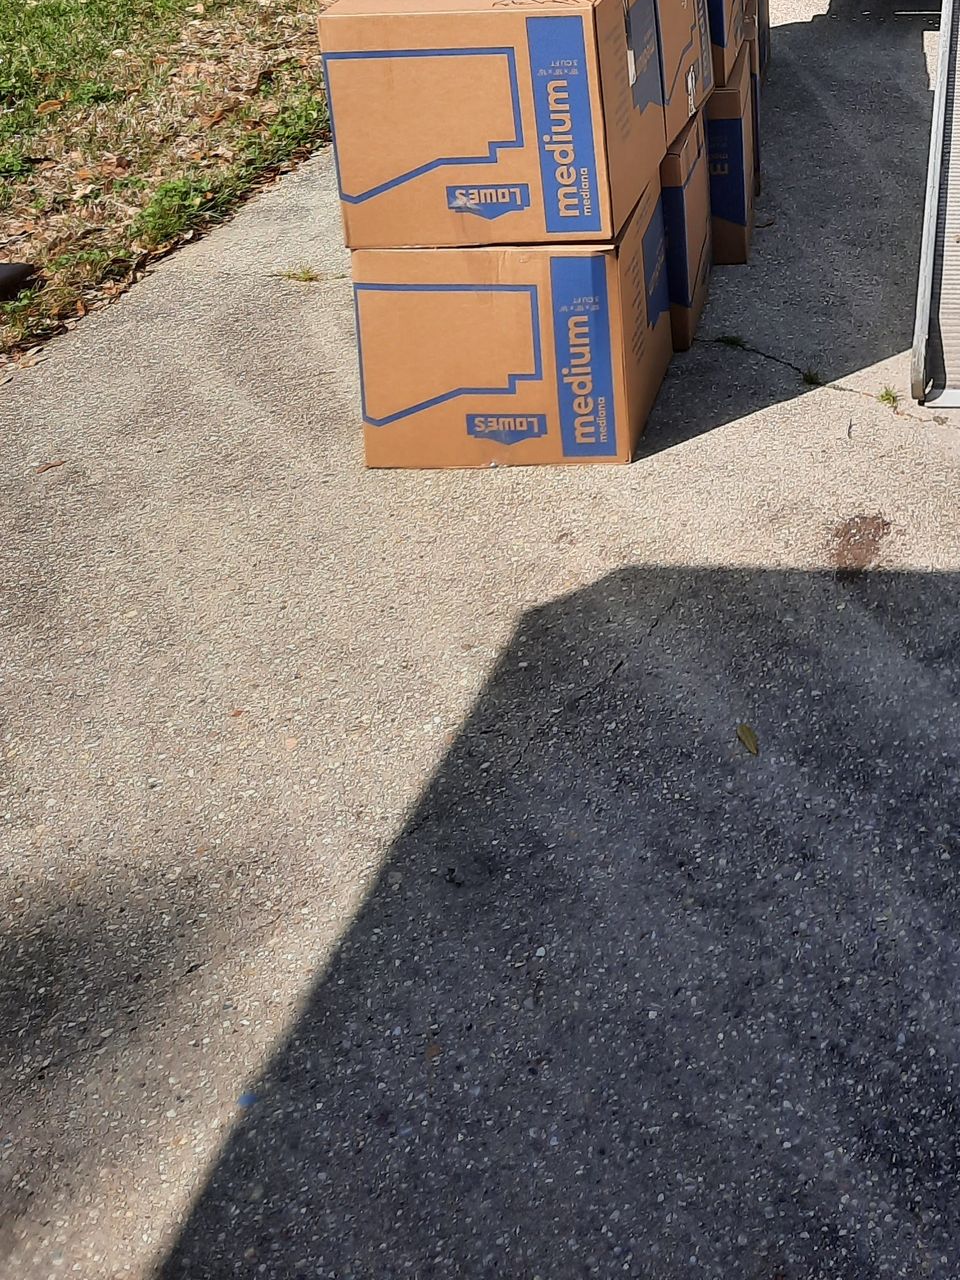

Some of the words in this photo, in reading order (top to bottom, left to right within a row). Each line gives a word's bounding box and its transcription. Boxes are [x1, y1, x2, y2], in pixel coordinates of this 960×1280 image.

[543, 80, 580, 218] medium
[579, 167, 592, 216] mediana
[562, 315, 596, 444] medium
[596, 396, 608, 442] mediana
